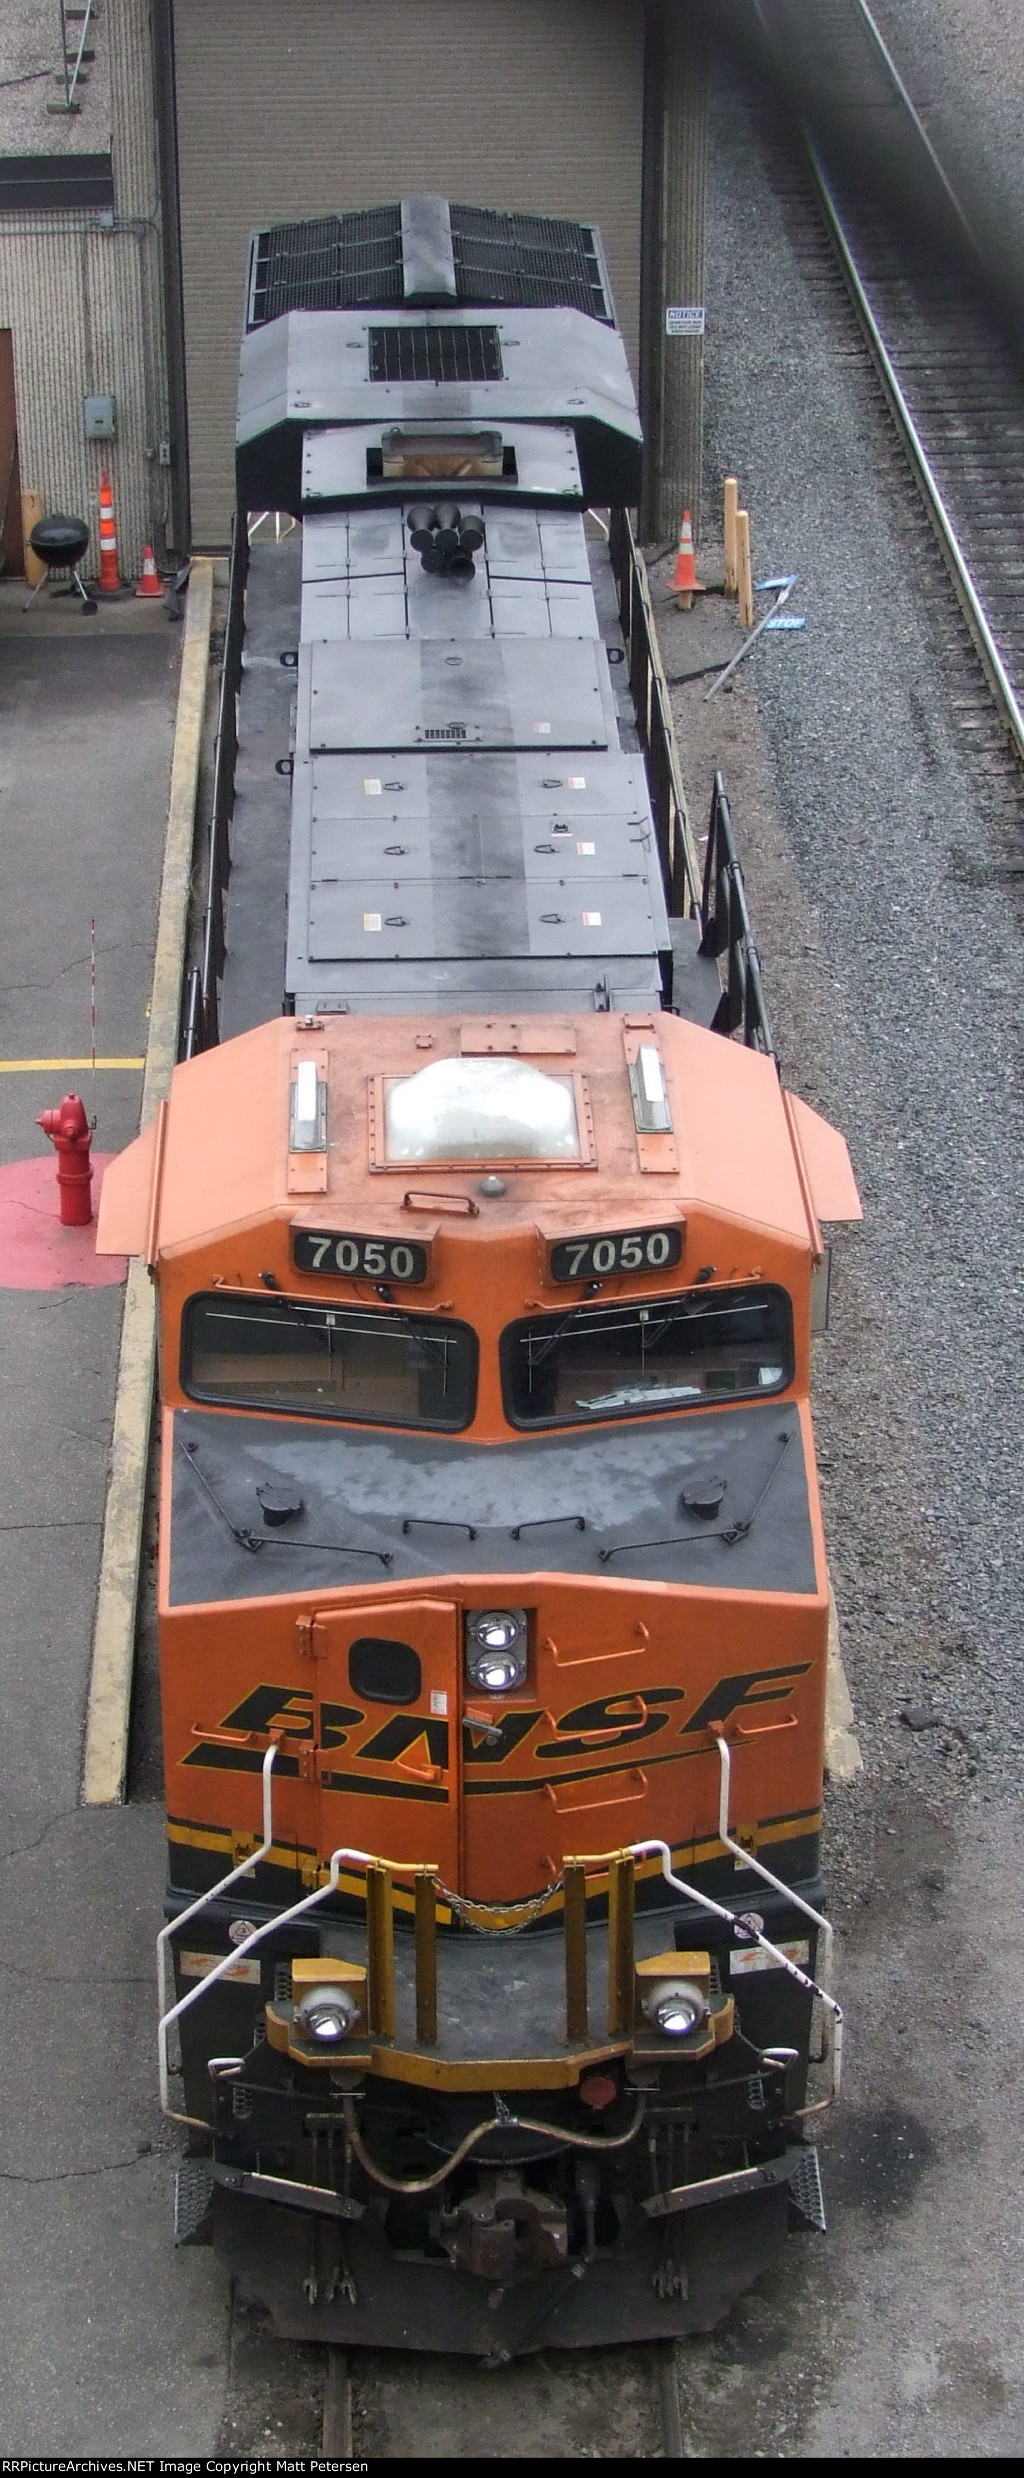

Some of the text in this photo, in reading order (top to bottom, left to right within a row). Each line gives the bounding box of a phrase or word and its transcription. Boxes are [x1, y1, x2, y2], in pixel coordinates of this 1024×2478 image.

[669, 310, 701, 318] NOTICE
[308, 1236, 414, 1278] 7050
[565, 1232, 670, 1276] 7050
[216, 1660, 817, 1772] BNSF
